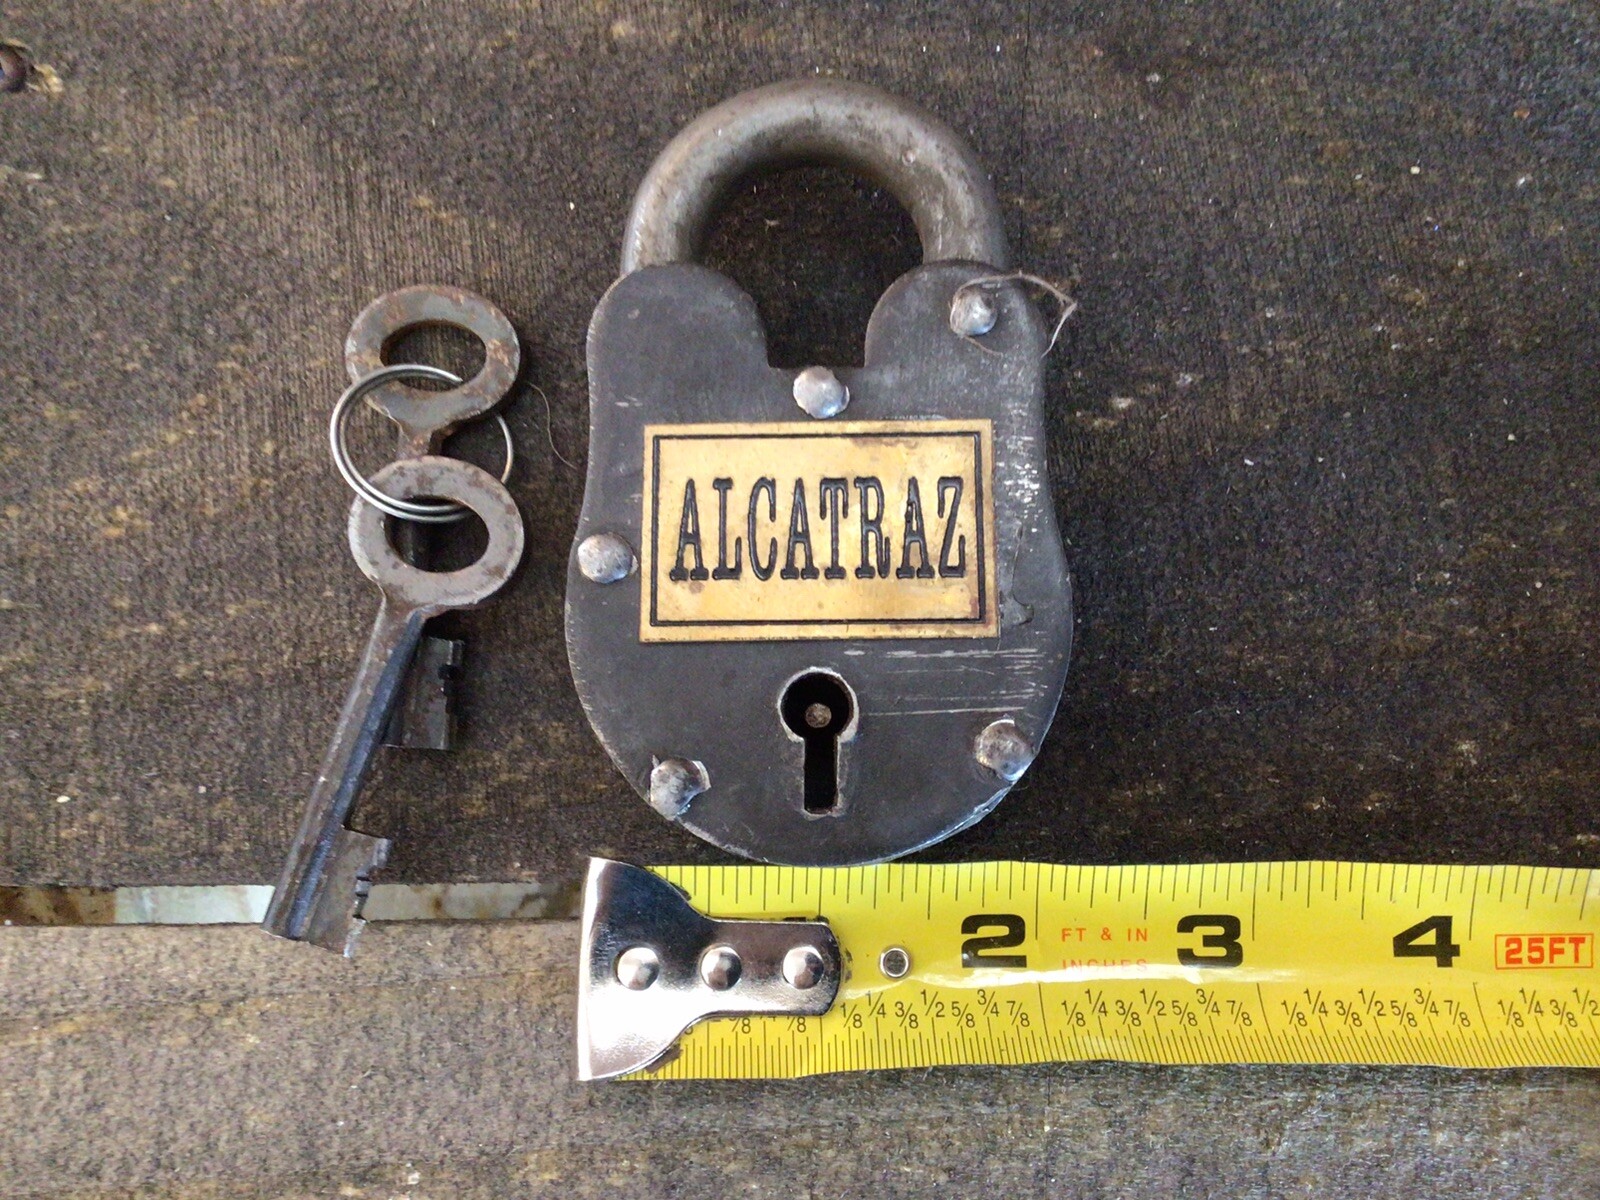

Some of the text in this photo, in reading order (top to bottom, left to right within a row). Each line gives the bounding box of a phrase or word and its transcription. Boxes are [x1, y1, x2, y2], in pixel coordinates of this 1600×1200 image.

[669, 476, 966, 582] ALCATRAZ
[961, 914, 1027, 968] 2
[1061, 926, 1148, 942] FT & IN
[1177, 914, 1244, 969] 3
[1393, 915, 1460, 968] 4
[1505, 937, 1586, 965] 25FT
